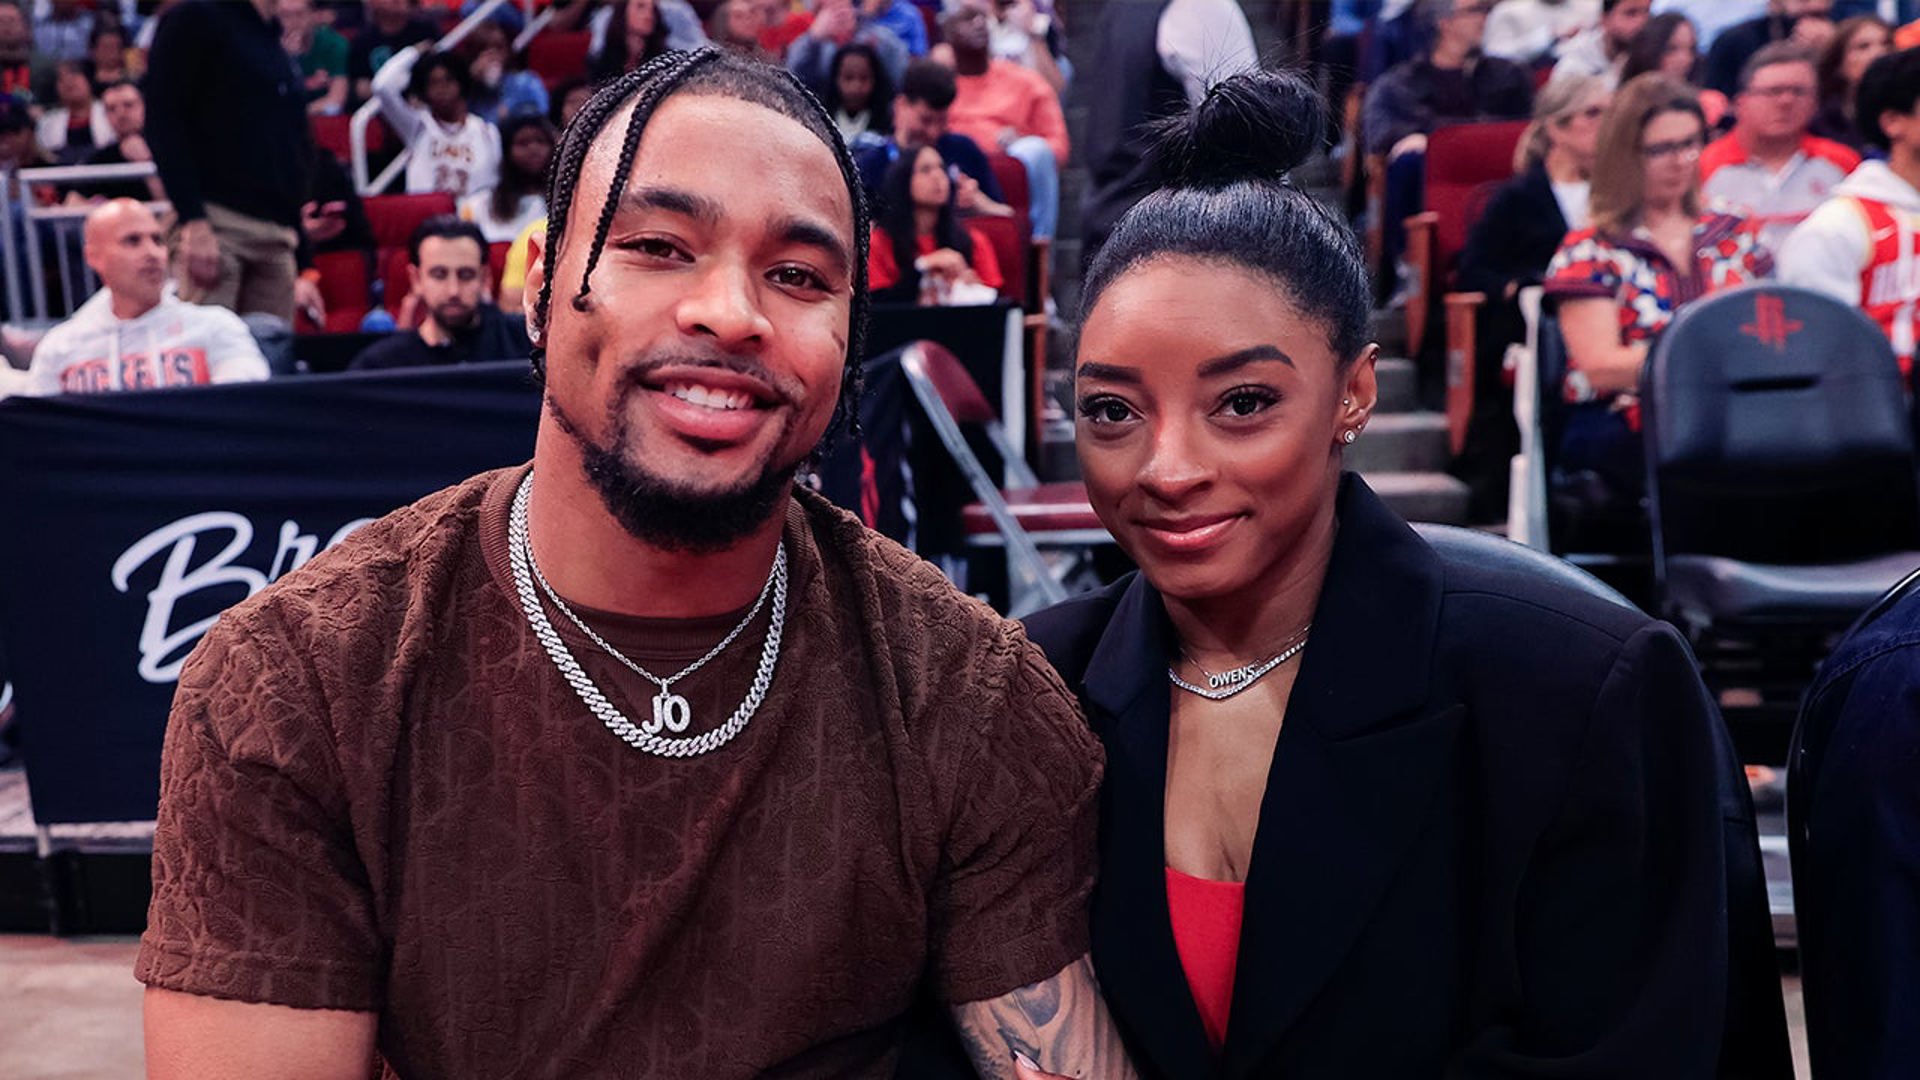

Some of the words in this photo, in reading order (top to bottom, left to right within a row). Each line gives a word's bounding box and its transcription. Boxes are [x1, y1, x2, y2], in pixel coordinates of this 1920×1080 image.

[112, 511, 375, 682] Br
[1209, 666, 1256, 688] OWENS
[642, 695, 691, 734] JO
